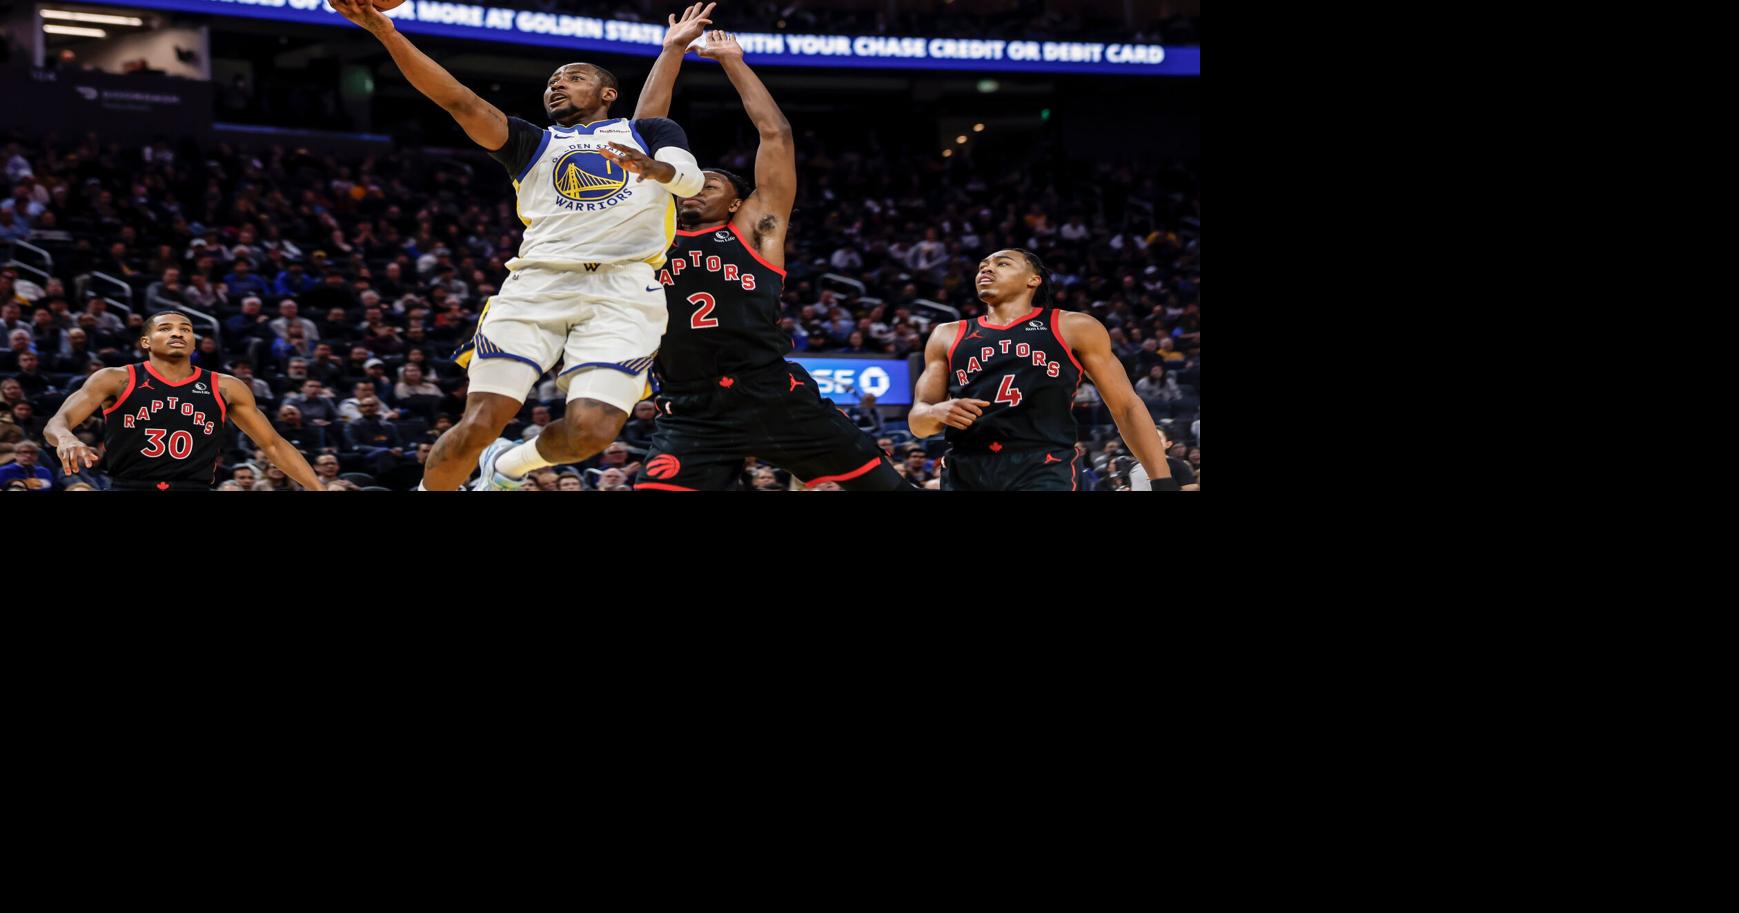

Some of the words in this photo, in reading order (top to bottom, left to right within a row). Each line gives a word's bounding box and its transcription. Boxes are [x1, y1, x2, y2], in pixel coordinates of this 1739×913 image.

[417, 1, 484, 26] MORE
[485, 8, 515, 30] AT
[516, 11, 603, 40] GOLDEN
[605, 20, 664, 45] STATE
[787, 35, 850, 56] YOUR
[853, 37, 927, 58] CHASE
[928, 39, 1006, 60] CREDIT
[1007, 41, 1041, 61] OR
[1042, 43, 1104, 63] DEBIT
[1105, 45, 1165, 64] CARD
[555, 188, 633, 211] WARRIORS
[659, 250, 756, 290] APTORS
[686, 292, 719, 329] 2
[956, 340, 1060, 385] RAPTORS
[995, 374, 1023, 408] 4
[124, 397, 215, 435] RAPTORS
[140, 428, 193, 460] 30
